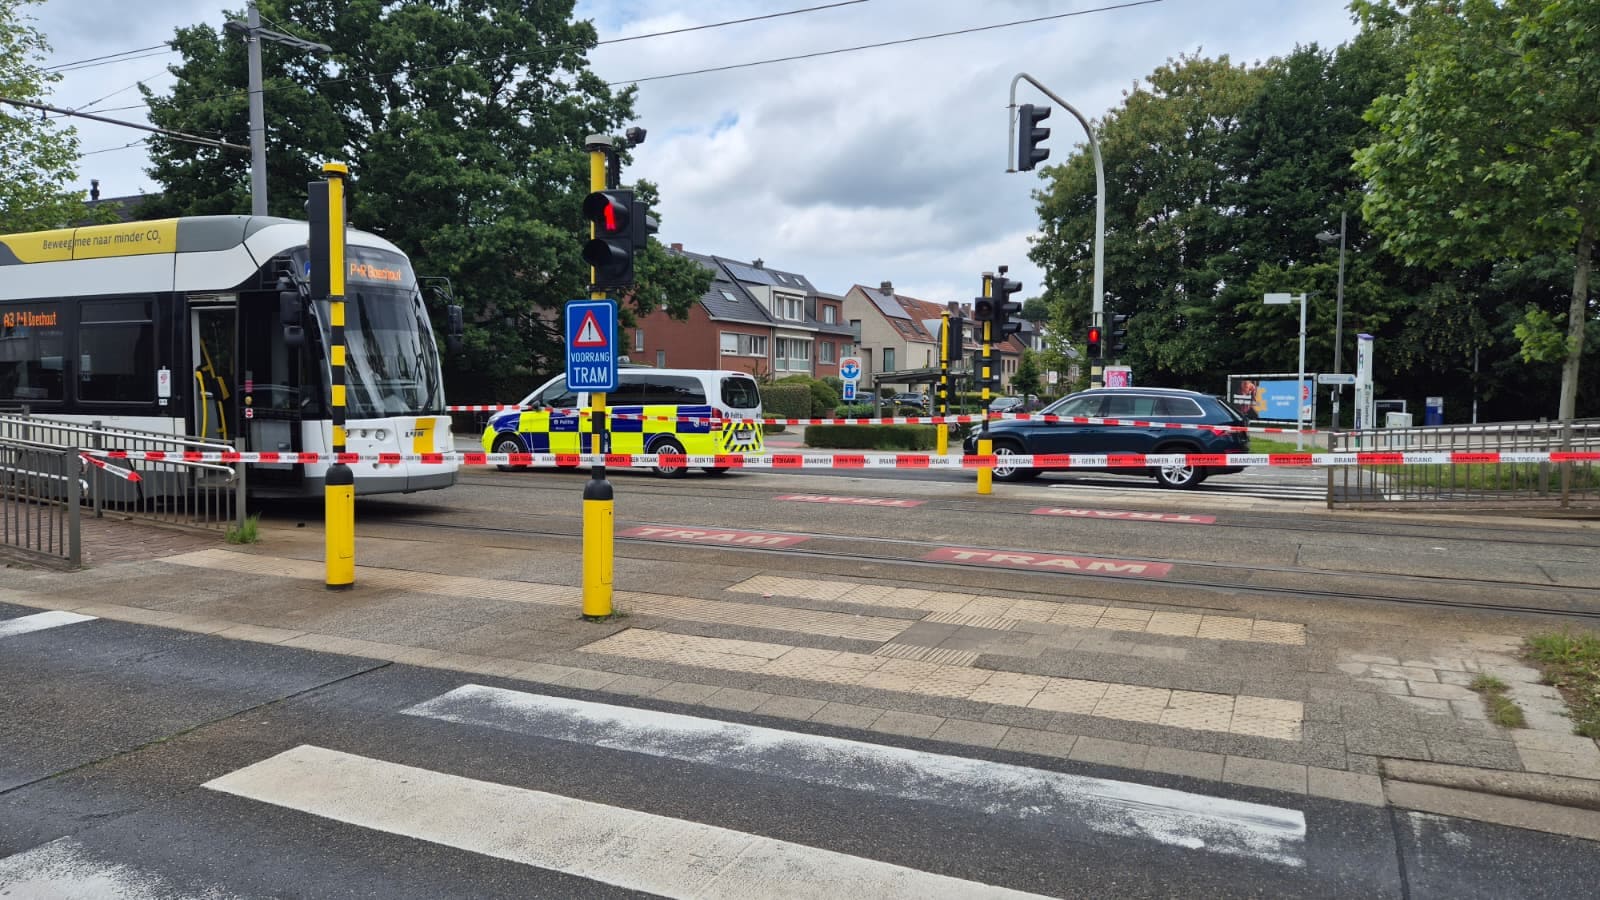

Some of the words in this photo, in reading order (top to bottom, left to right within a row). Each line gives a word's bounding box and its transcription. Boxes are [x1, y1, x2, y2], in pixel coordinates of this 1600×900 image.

[42, 239, 73, 251] Beweeg
[74, 237, 92, 247] mee
[93, 235, 111, 246] naar
[114, 232, 144, 244] minder
[4, 312, 15, 328] A3
[570, 351, 610, 363] VOORRANG
[573, 366, 608, 384] TRAM
[637, 527, 792, 545] TRAM
[951, 549, 1147, 574] TRAM
